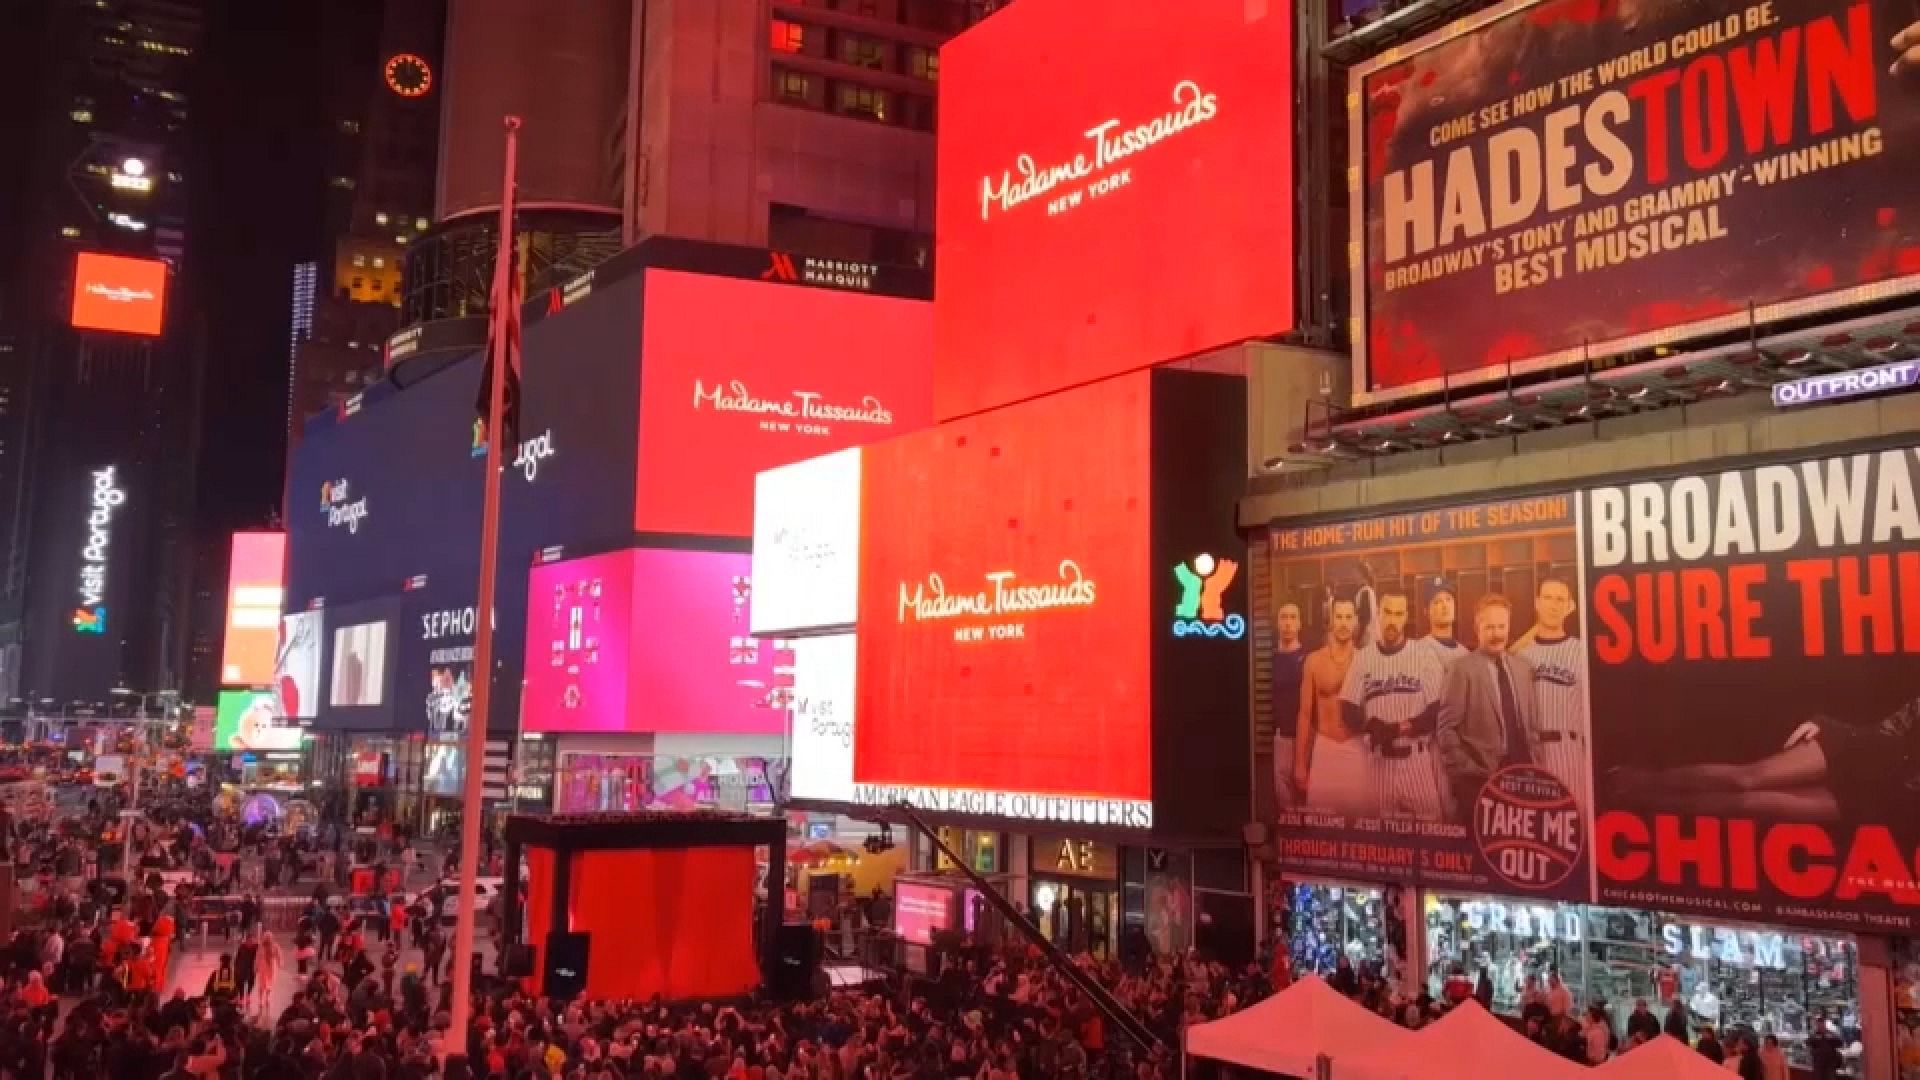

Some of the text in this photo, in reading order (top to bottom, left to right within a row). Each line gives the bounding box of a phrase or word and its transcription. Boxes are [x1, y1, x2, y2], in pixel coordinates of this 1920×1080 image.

[1430, 1, 1781, 147] COME SEE HOW THE WORLD COULD BE.
[980, 79, 1218, 221] Madame Tussauds
[1383, 3, 1879, 263] HADESTOWN
[1047, 168, 1133, 217] NEW YORK
[805, 257, 878, 277] MARRIOTT
[1384, 239, 1505, 292] BROADWAY'S
[1574, 208, 1619, 239] AND
[1494, 205, 1728, 295] BEST MUSICAL
[805, 271, 871, 289] MARQUIS
[693, 378, 893, 425] Madame Tussauds
[1779, 365, 1914, 401] OUTFRONT
[758, 420, 830, 437] NEW YORK
[83, 465, 125, 561] Portugal
[1272, 496, 1568, 551] THE HOME-RUN HIT OF THE SEASON!
[1591, 447, 1920, 568] BROADWA
[898, 559, 1097, 624] Madame Tussauds
[954, 623, 1026, 643] NEW YORK
[1594, 571, 1771, 665] SURE
[853, 785, 1151, 829] AMERICAN EAGLE OUTFITTERS
[1481, 797, 1577, 853] TAKE ME
[1057, 837, 1093, 872] AE
[1280, 838, 1337, 858] THROUGH
[1342, 841, 1414, 866] FEBRUARY
[1435, 850, 1473, 873] ONLY
[1501, 847, 1552, 882] OUT
[1597, 811, 1920, 906] CHICA
[1464, 901, 1581, 942] GRAND
[1662, 923, 1788, 970] SLAM
